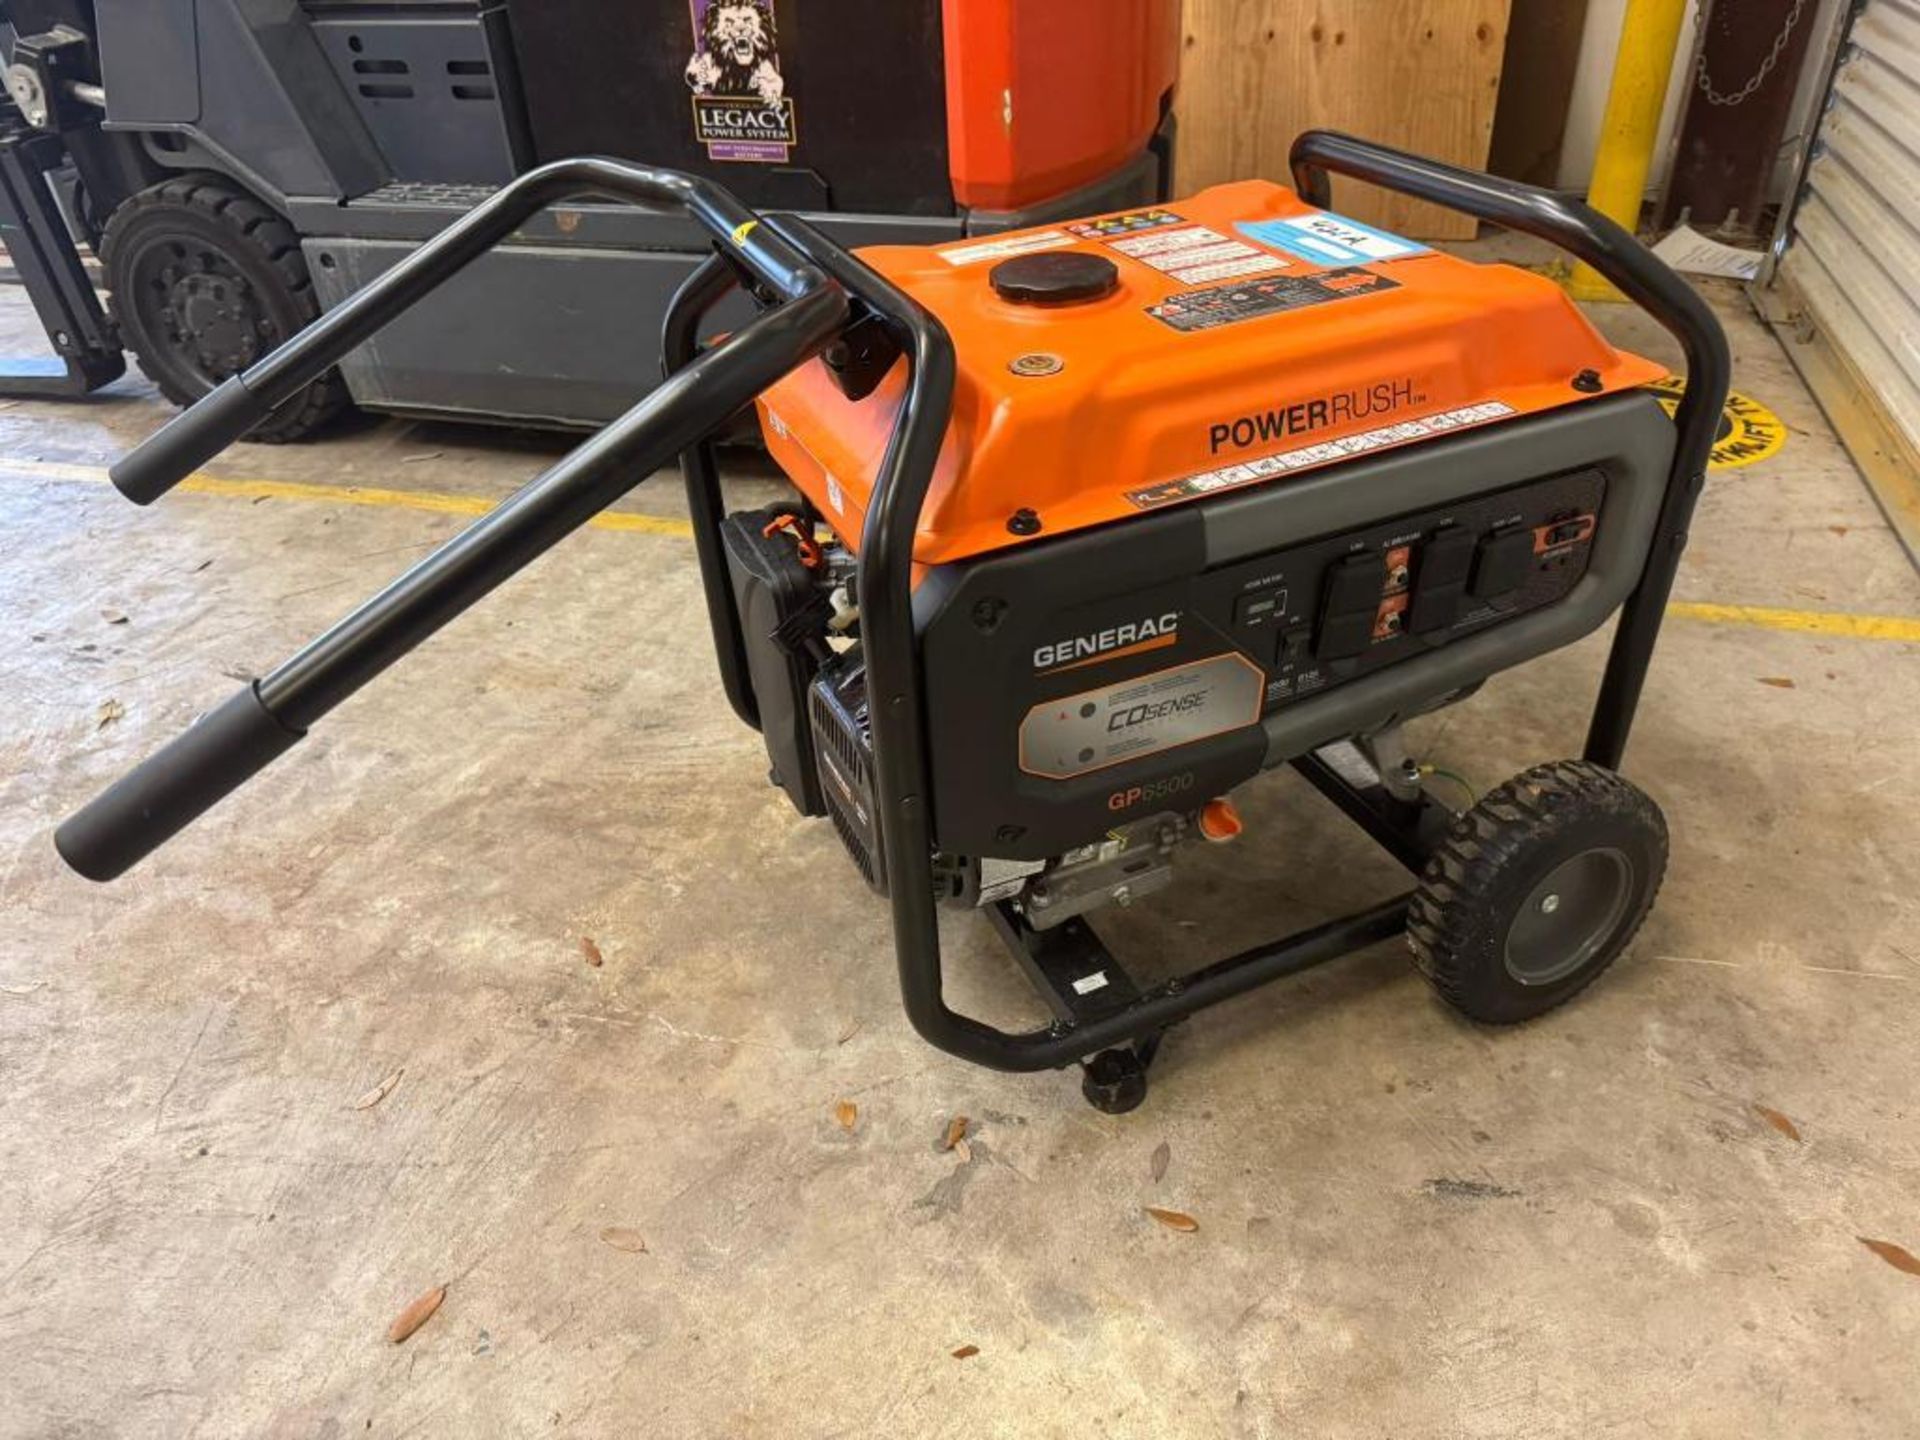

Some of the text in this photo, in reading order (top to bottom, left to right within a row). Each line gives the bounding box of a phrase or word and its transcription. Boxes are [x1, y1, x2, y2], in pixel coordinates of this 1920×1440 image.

[700, 107, 790, 129] LEGACY
[703, 128, 790, 139] POWER SYSTEM
[1033, 613, 1179, 668] GENERAC
[1108, 772, 1195, 811] GP6500
